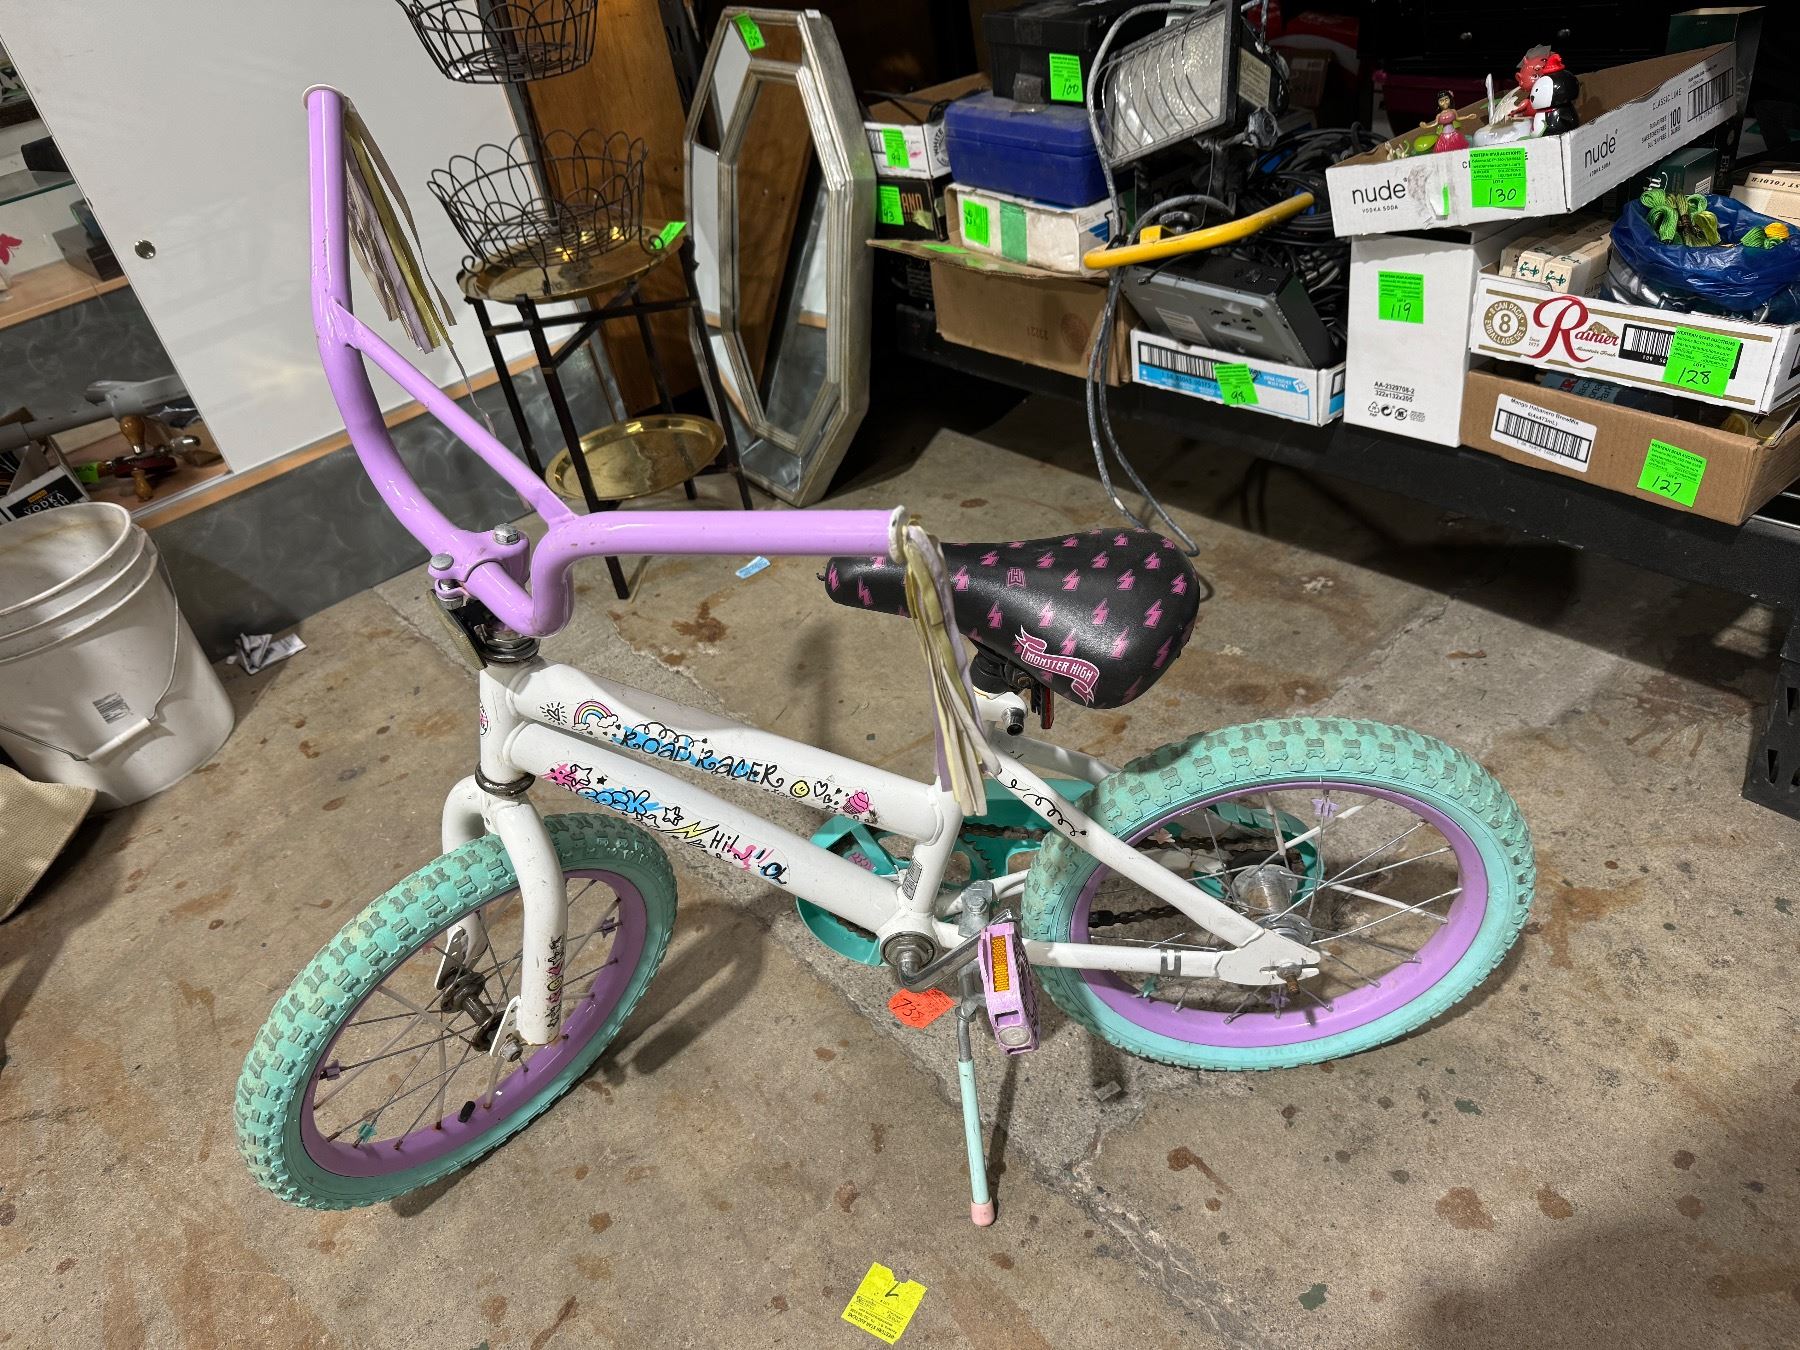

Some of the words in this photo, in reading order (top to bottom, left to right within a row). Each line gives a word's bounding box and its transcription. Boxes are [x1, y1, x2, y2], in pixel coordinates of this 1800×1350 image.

[1062, 82, 1079, 96] 100
[1653, 94, 1671, 111] CLASSIC
[1670, 106, 1682, 129] 100
[1584, 133, 1617, 168] nude
[1352, 180, 1406, 205] nude
[1489, 187, 1517, 205] 130
[1391, 303, 1411, 322] 119
[1494, 302, 1508, 310] CAN
[1509, 303, 1524, 320] PACK
[1485, 320, 1515, 344] EMBALLAGE
[1499, 313, 1511, 333] 8
[1527, 295, 1619, 362] Rainier
[1678, 367, 1712, 385] 128
[1510, 398, 1529, 408] Mango
[1529, 404, 1555, 417] Habanero
[1652, 476, 1682, 496] 127
[24, 492, 69, 515] VODKA
[1024, 651, 1071, 674] MONSTER
[1069, 663, 1093, 683] HIGH
[710, 830, 736, 855] Hi!
